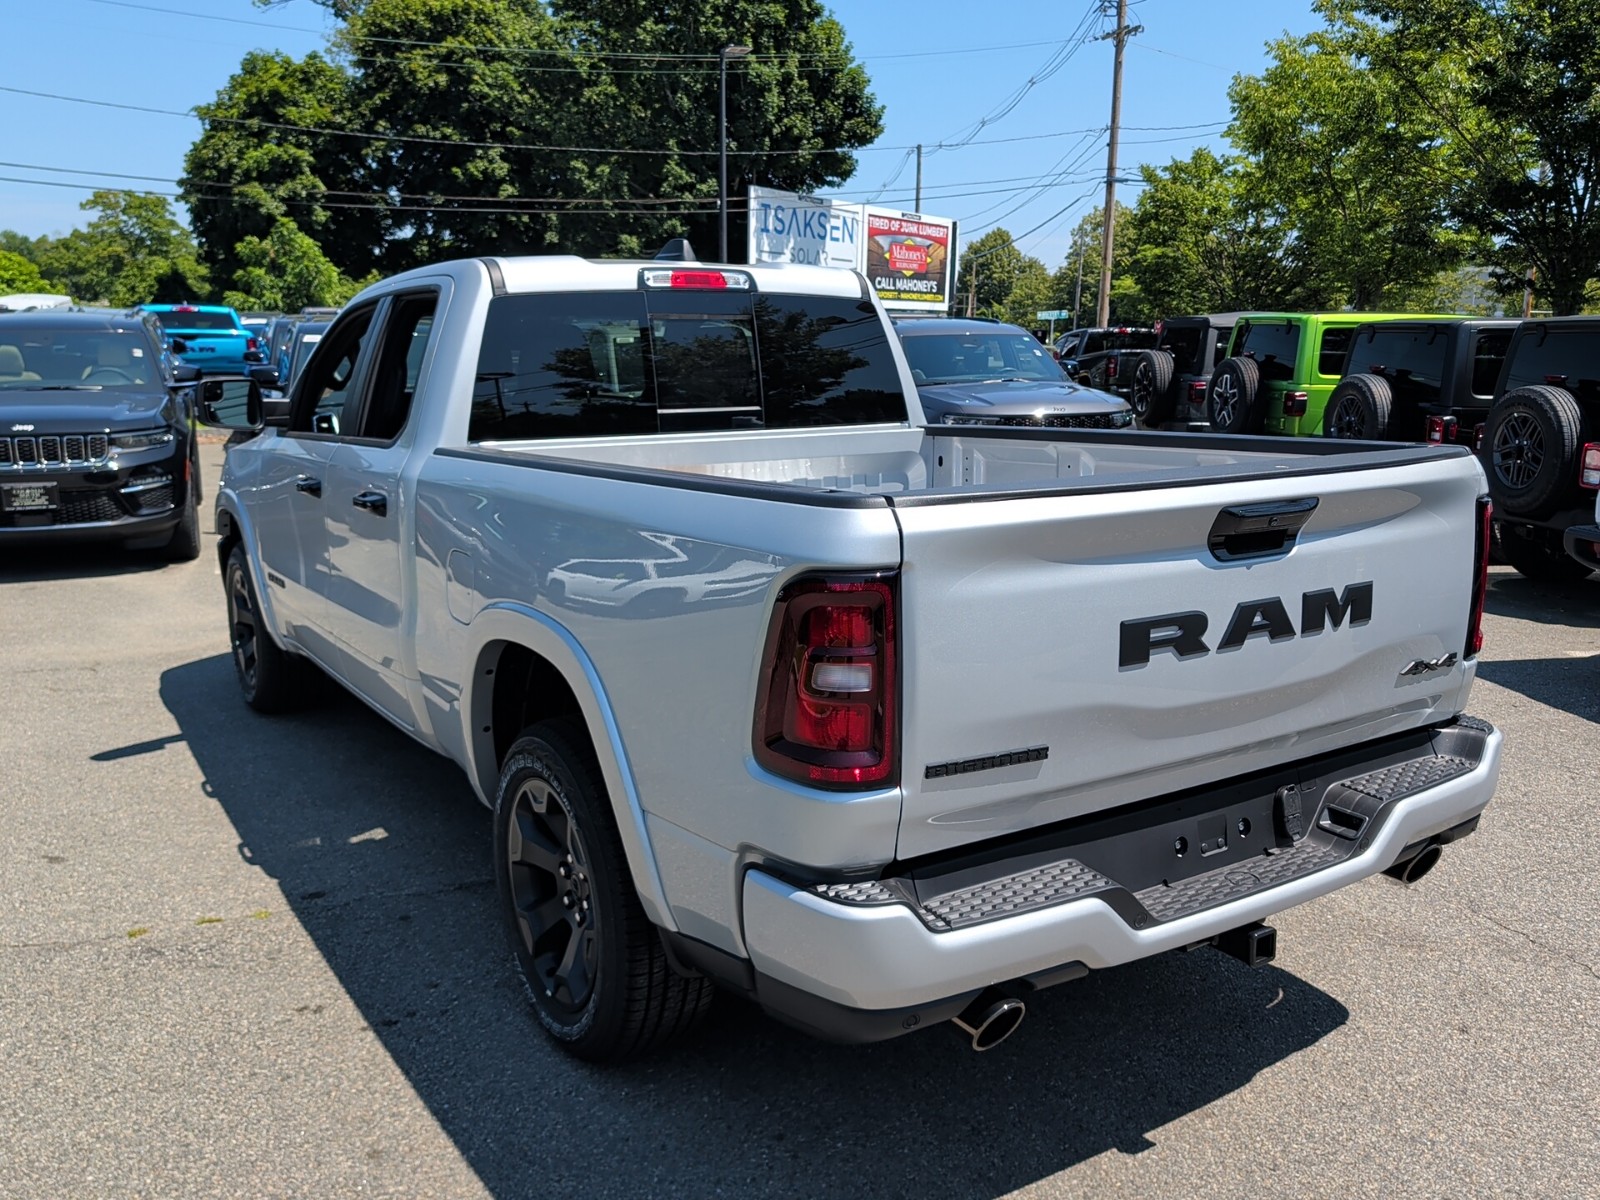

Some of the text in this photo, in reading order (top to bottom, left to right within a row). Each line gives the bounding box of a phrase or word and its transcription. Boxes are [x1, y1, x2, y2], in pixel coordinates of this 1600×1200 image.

[760, 203, 855, 244] ISAKSEN
[869, 217, 889, 230] TIRED
[890, 220, 900, 231] OF
[901, 221, 918, 234] JUNK
[790, 247, 829, 266] SOLAR
[875, 277, 938, 293] CALL MAHONEY'S
[1119, 580, 1374, 668] RAM
